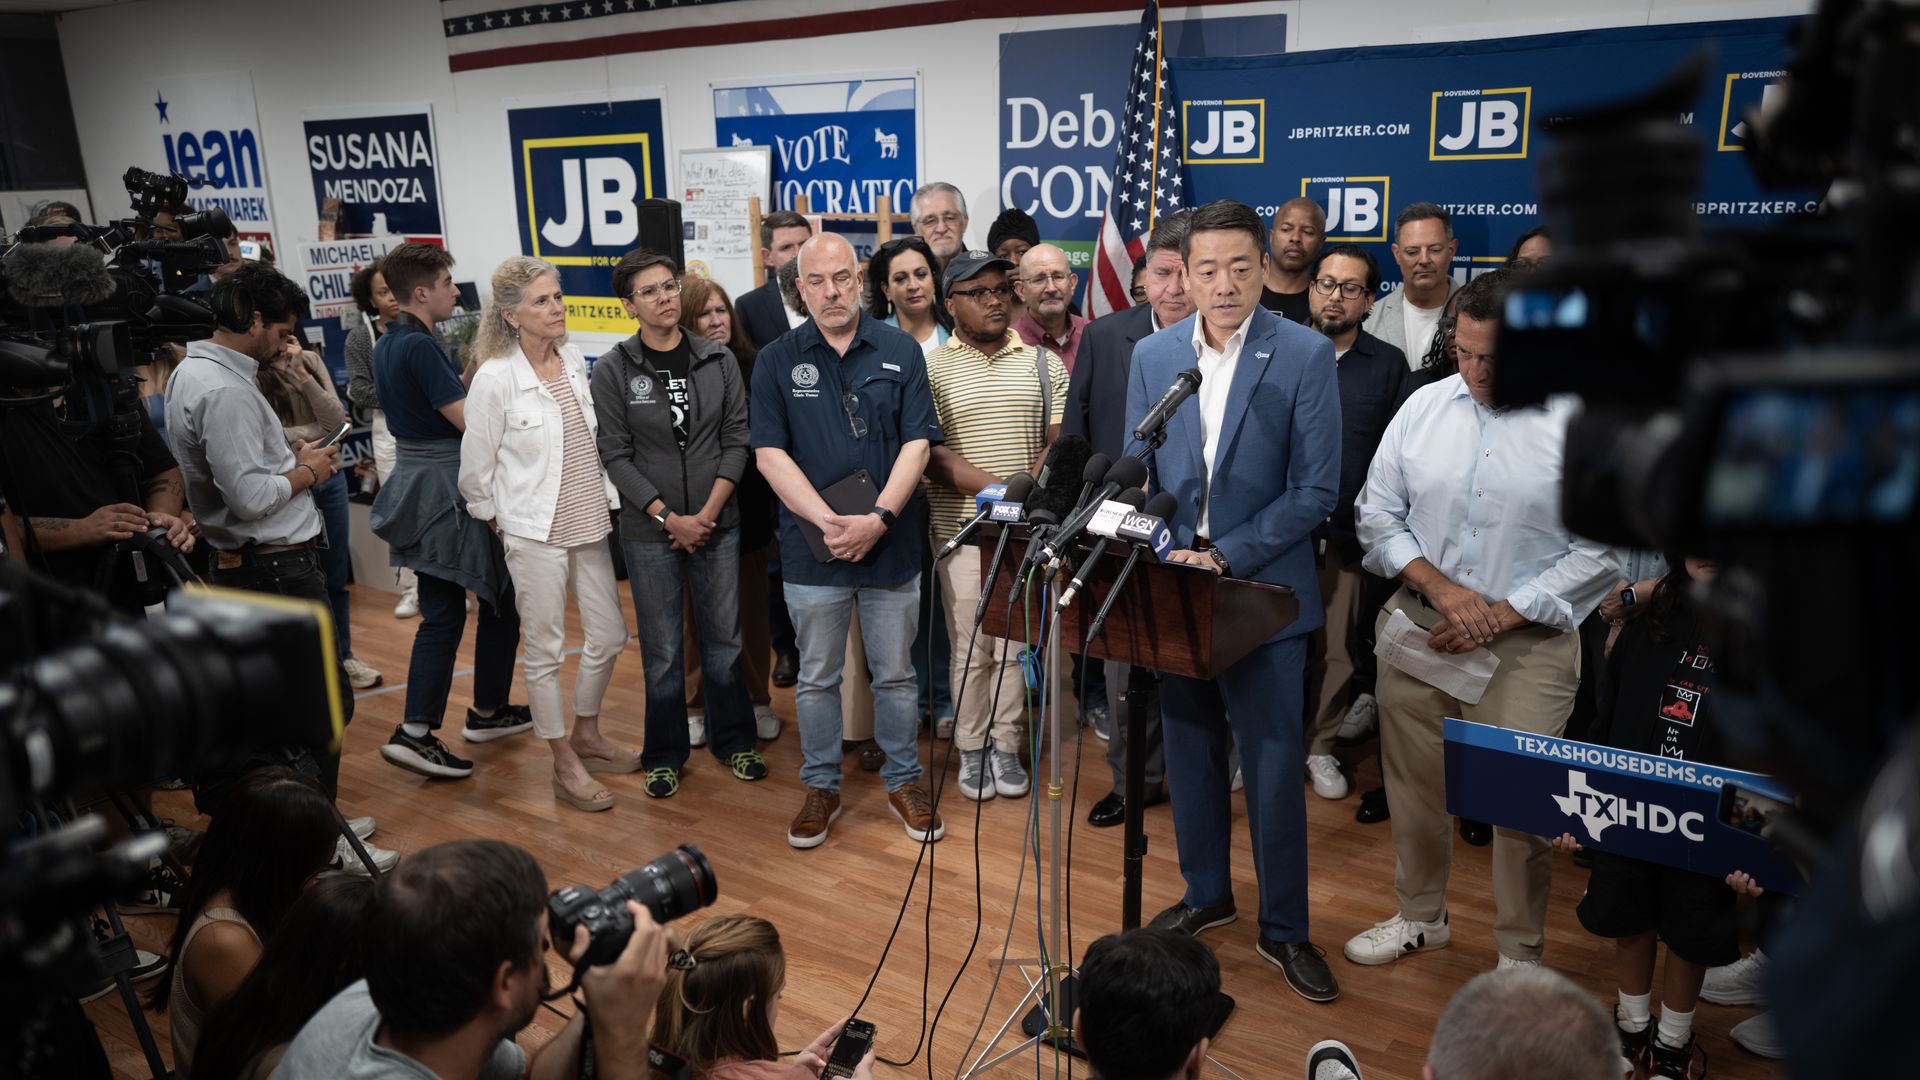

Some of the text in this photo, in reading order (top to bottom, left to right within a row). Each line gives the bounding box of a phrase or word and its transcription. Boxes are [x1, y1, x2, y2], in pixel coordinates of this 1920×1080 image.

[1741, 71, 1788, 79] GOVERNOR
[1192, 99, 1223, 107] GOVERNOR
[1443, 89, 1481, 97] GOVERNOR
[1006, 92, 1116, 149] Deb
[1288, 123, 1411, 140] JBPRITZKER.COM
[1438, 100, 1519, 151] JB
[1190, 110, 1256, 155] JB
[308, 130, 433, 171] SUSANA
[775, 125, 850, 173] VOTE
[324, 178, 428, 204] MENDOZA
[1312, 176, 1345, 184] GOVERNOR
[541, 157, 639, 248] JB
[1324, 187, 1379, 232] JB
[309, 244, 379, 266] MICHAEL
[592, 256, 610, 266] FOR
[1058, 247, 1090, 265] age
[309, 272, 354, 301] CHIL
[993, 505, 1020, 515] FOX 32
[1125, 514, 1158, 532] WGN
[1154, 528, 1171, 553] 9
